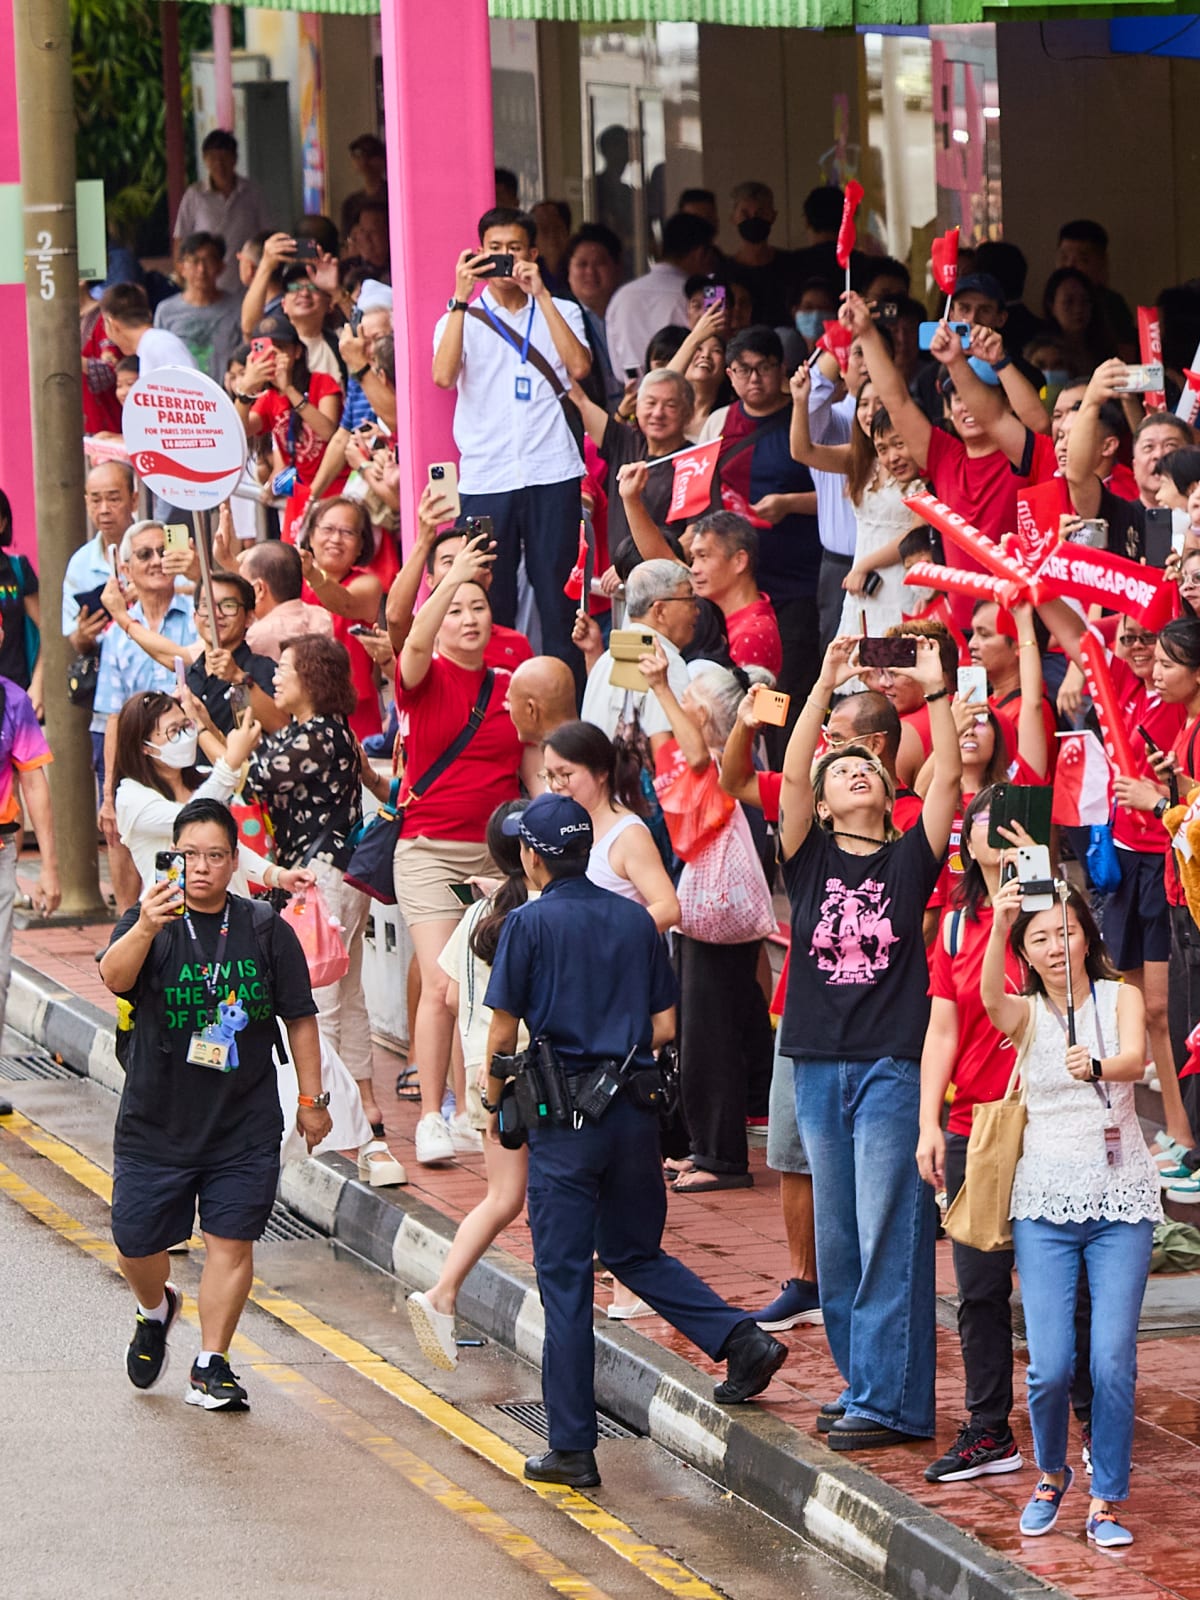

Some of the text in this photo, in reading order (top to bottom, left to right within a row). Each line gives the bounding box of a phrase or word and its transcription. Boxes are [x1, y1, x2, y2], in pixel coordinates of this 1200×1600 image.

[133, 392, 217, 412] CELEBRATORY
[157, 410, 206, 424] PARADE
[673, 470, 693, 511] team
[1070, 560, 1157, 608] SINGAPORE
[560, 822, 591, 836] POLICE
[237, 959, 257, 978] IS
[164, 986, 204, 1006] THE
